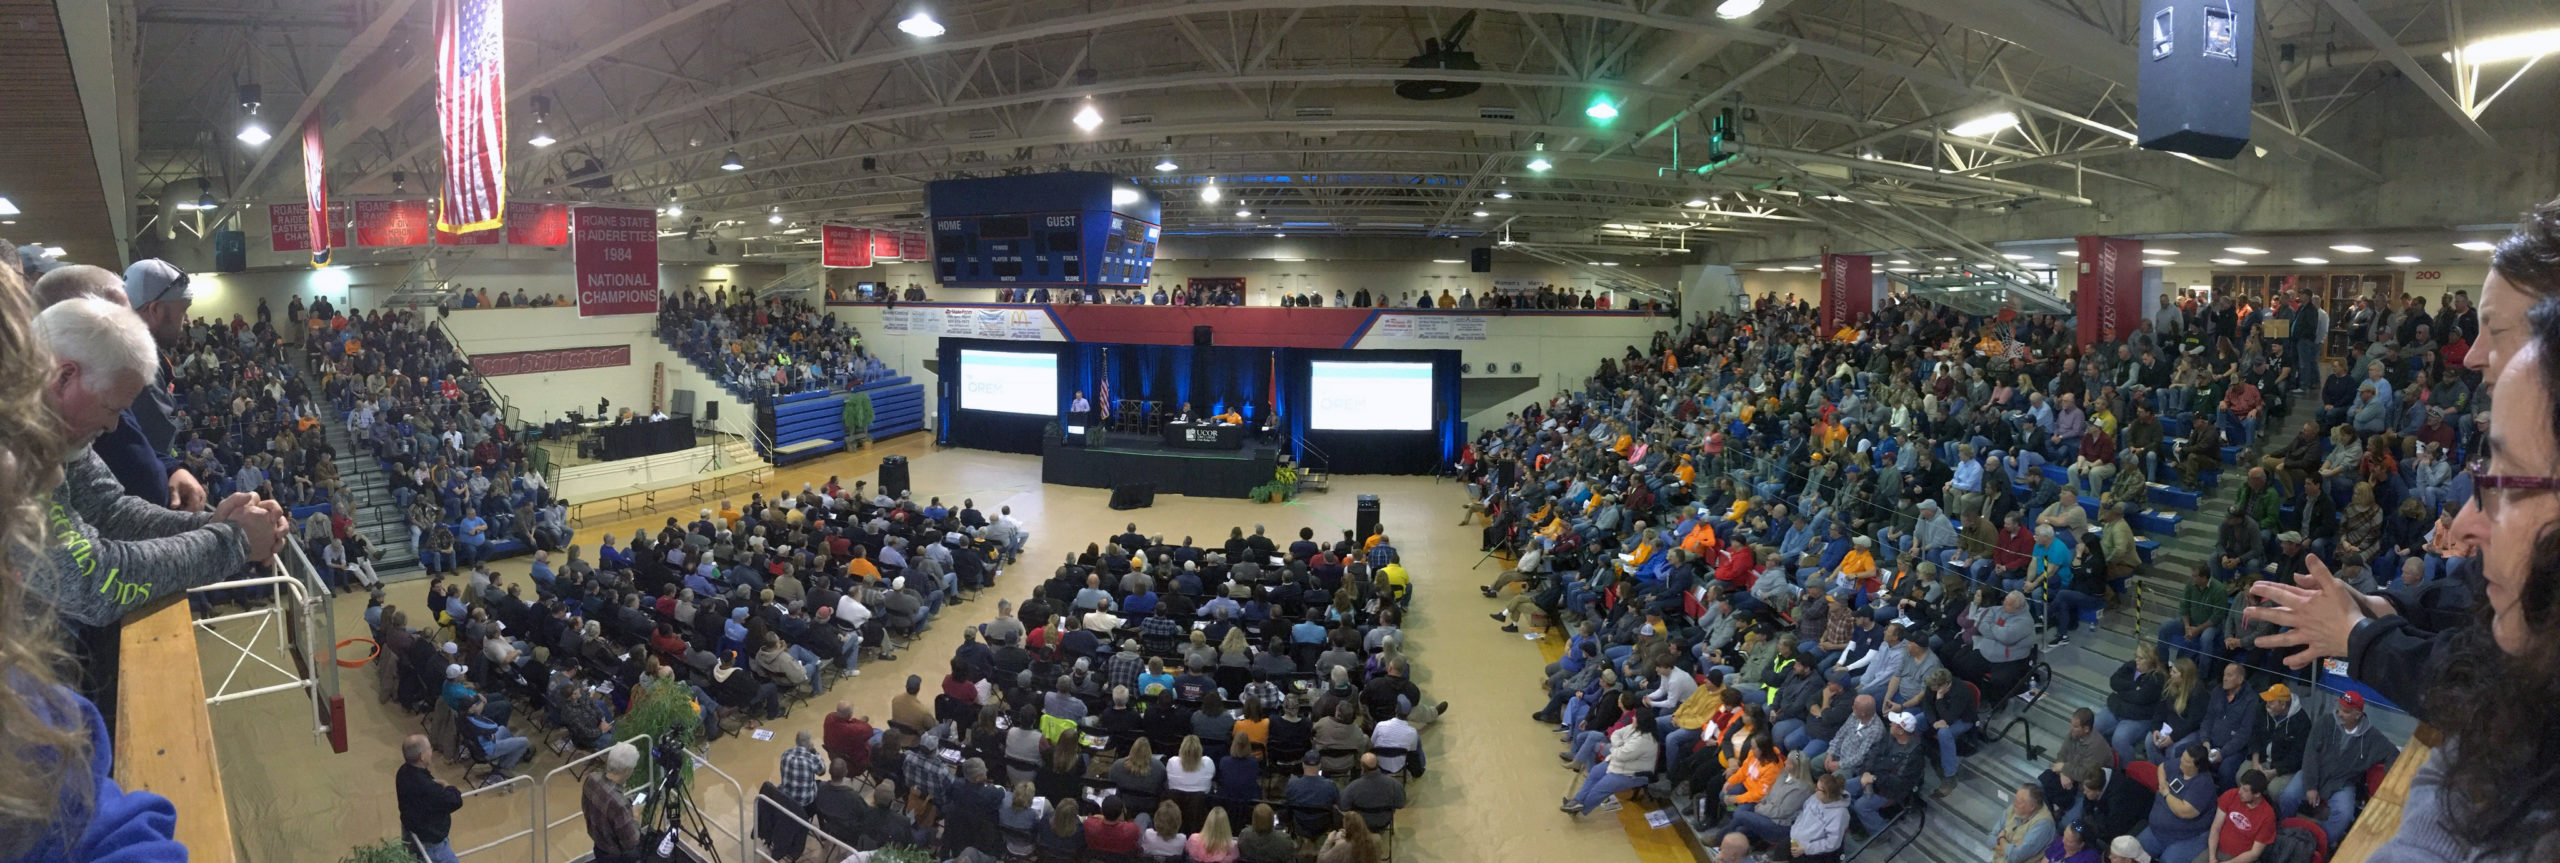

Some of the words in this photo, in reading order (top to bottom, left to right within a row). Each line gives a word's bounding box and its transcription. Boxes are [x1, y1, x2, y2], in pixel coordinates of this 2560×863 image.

[582, 215, 617, 227] ROANE
[619, 216, 650, 228] STATE
[938, 220, 962, 231] HOME
[1046, 216, 1076, 227] GUEST
[577, 229, 656, 242] RAIDERETTES
[603, 247, 632, 261] 1984
[588, 273, 651, 287] NATIONAL
[2415, 271, 2441, 280] 200
[582, 289, 657, 304] CHAMPIONS
